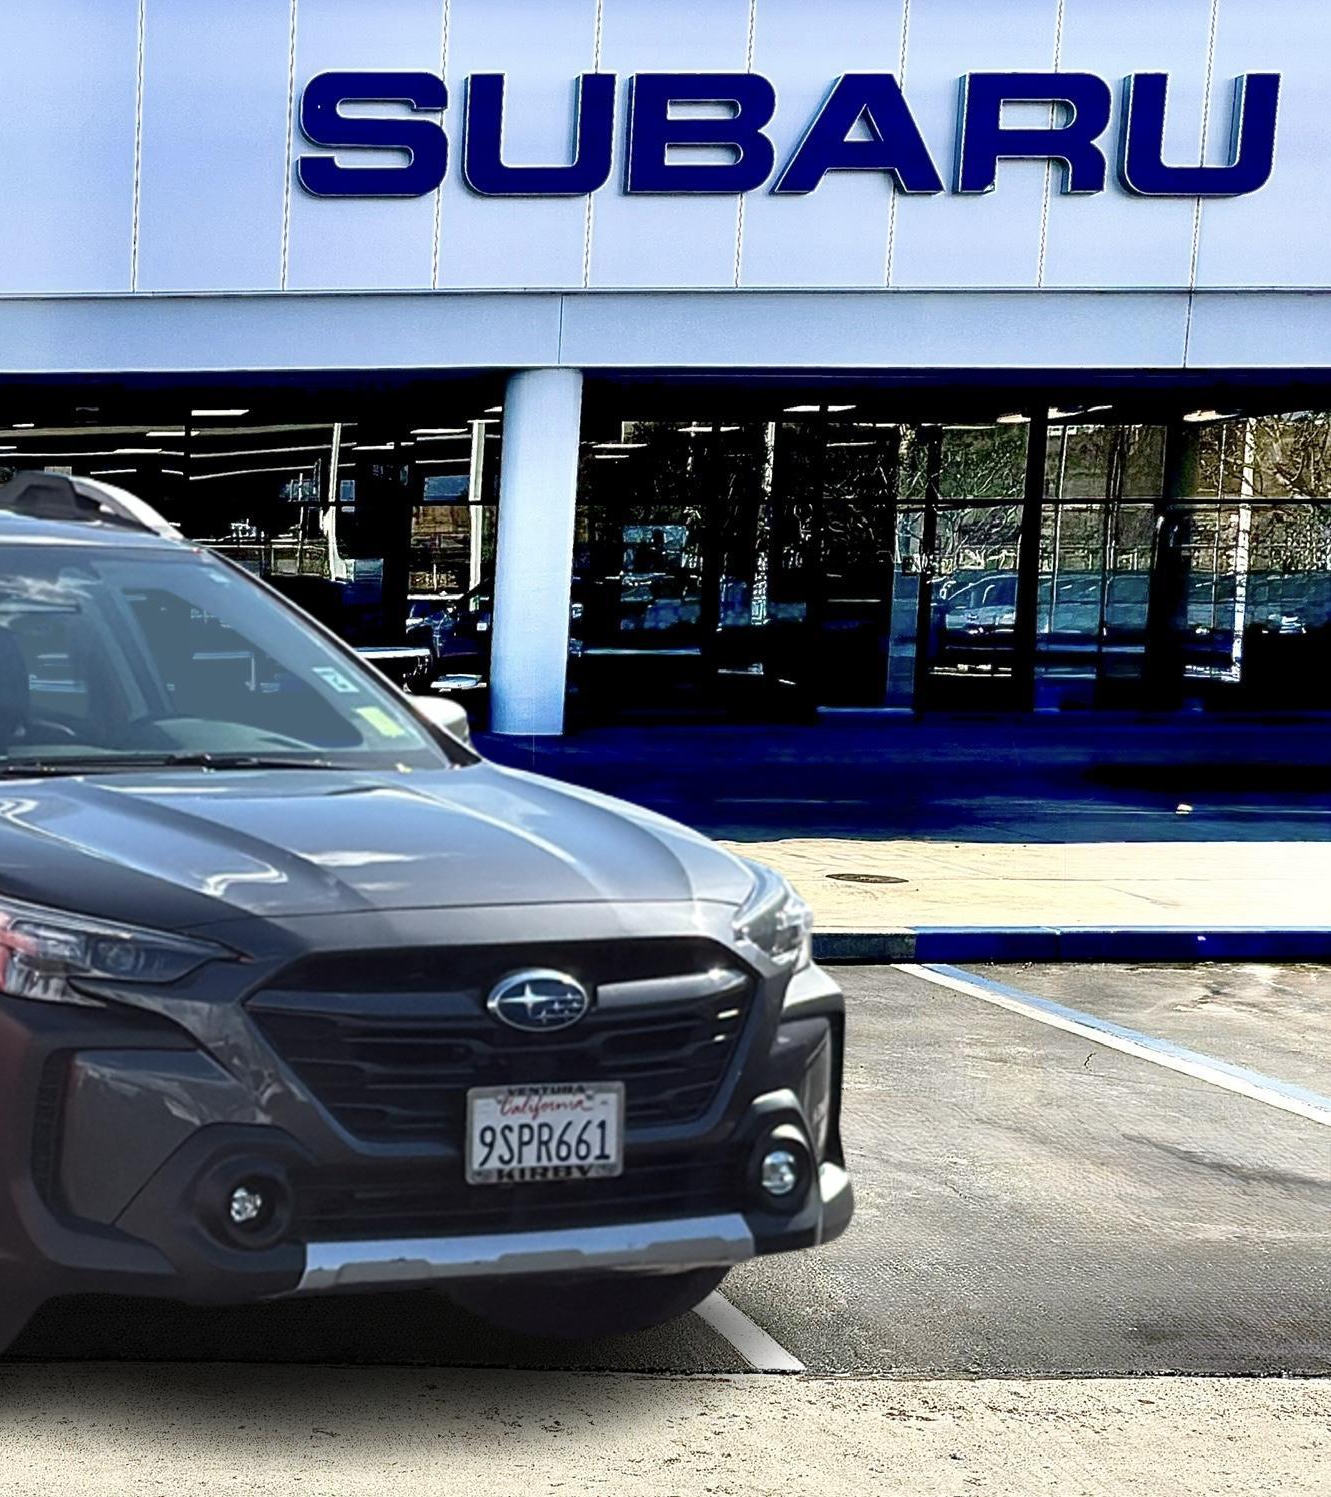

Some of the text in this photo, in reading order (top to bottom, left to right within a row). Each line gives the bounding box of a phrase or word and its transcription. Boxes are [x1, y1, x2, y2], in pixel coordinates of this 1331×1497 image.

[296, 72, 1281, 197] SUBARU
[507, 1084, 586, 1097] VENTURA
[499, 1096, 593, 1120] California
[478, 1119, 611, 1168] 9SPR661
[497, 1165, 593, 1182] KIRBY
